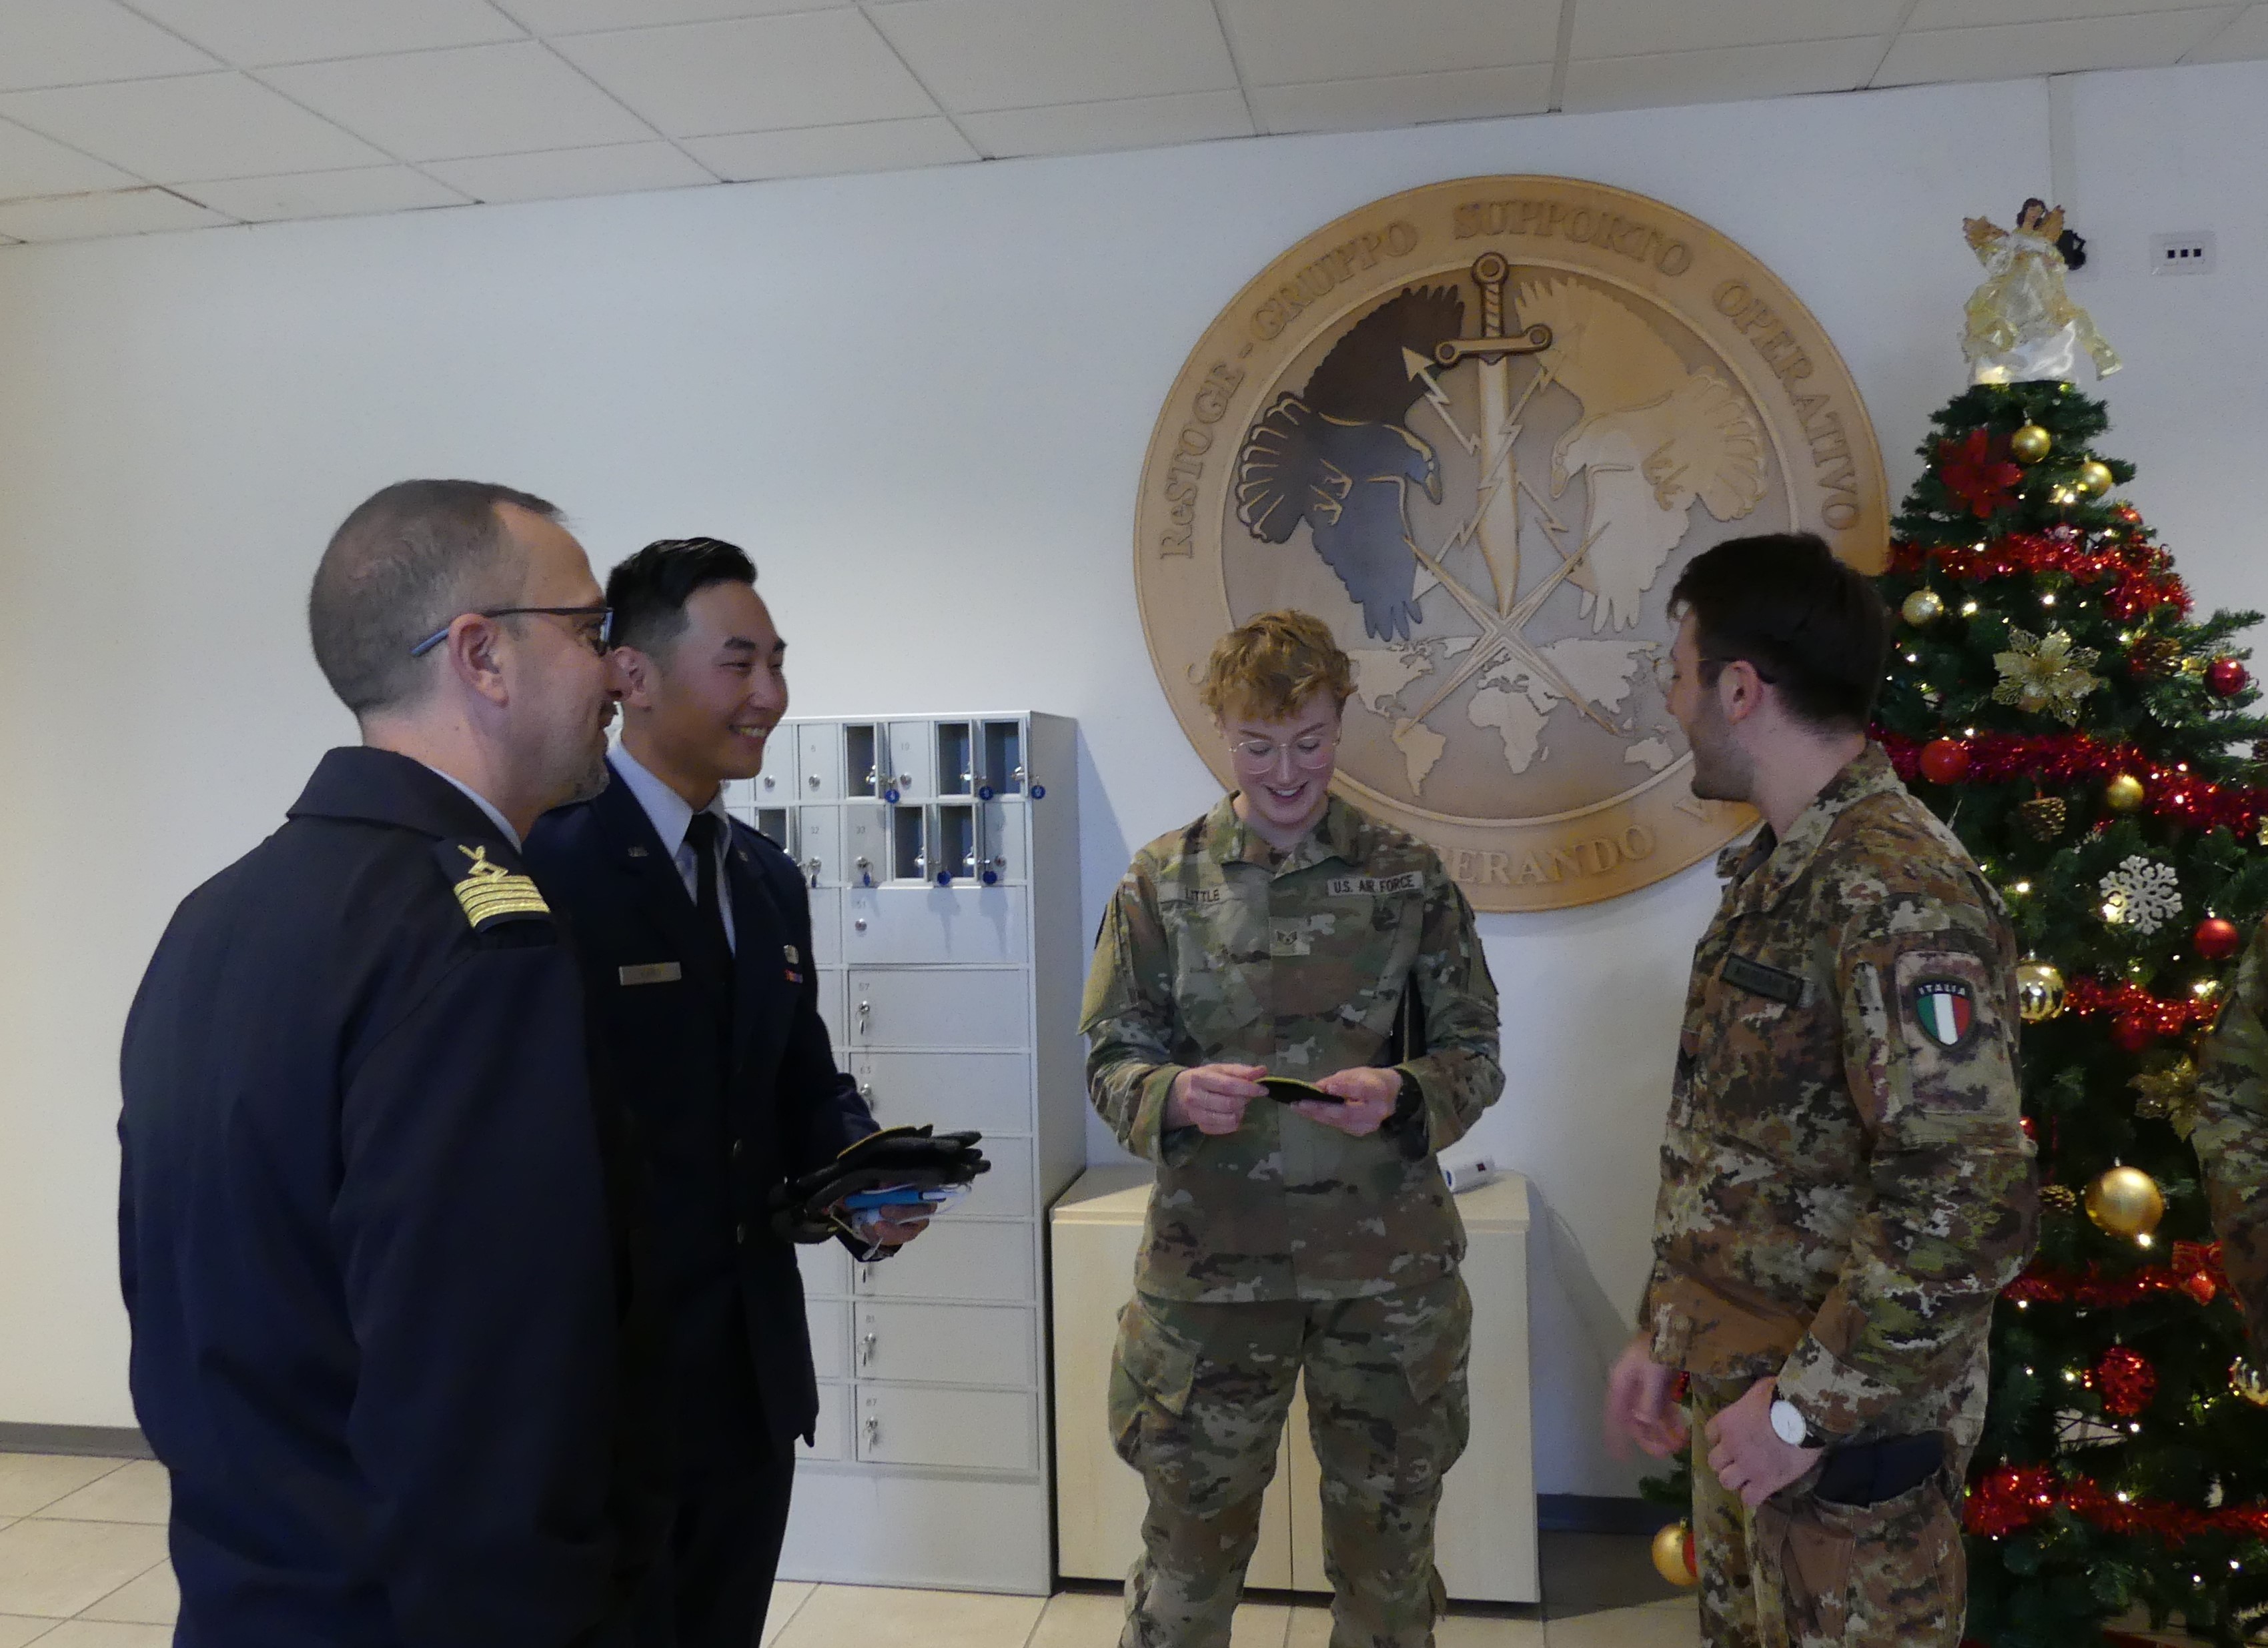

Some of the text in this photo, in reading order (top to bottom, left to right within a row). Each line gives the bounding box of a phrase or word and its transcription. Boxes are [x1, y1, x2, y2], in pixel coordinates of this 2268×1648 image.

[1251, 219, 1419, 341] GRUPPO
[1453, 199, 1694, 277] SUPPORTO
[1712, 279, 1860, 532] OPERATIVO
[1333, 874, 1415, 894] U.S. AIR FORCE
[1918, 983, 1966, 995] ITALIA
